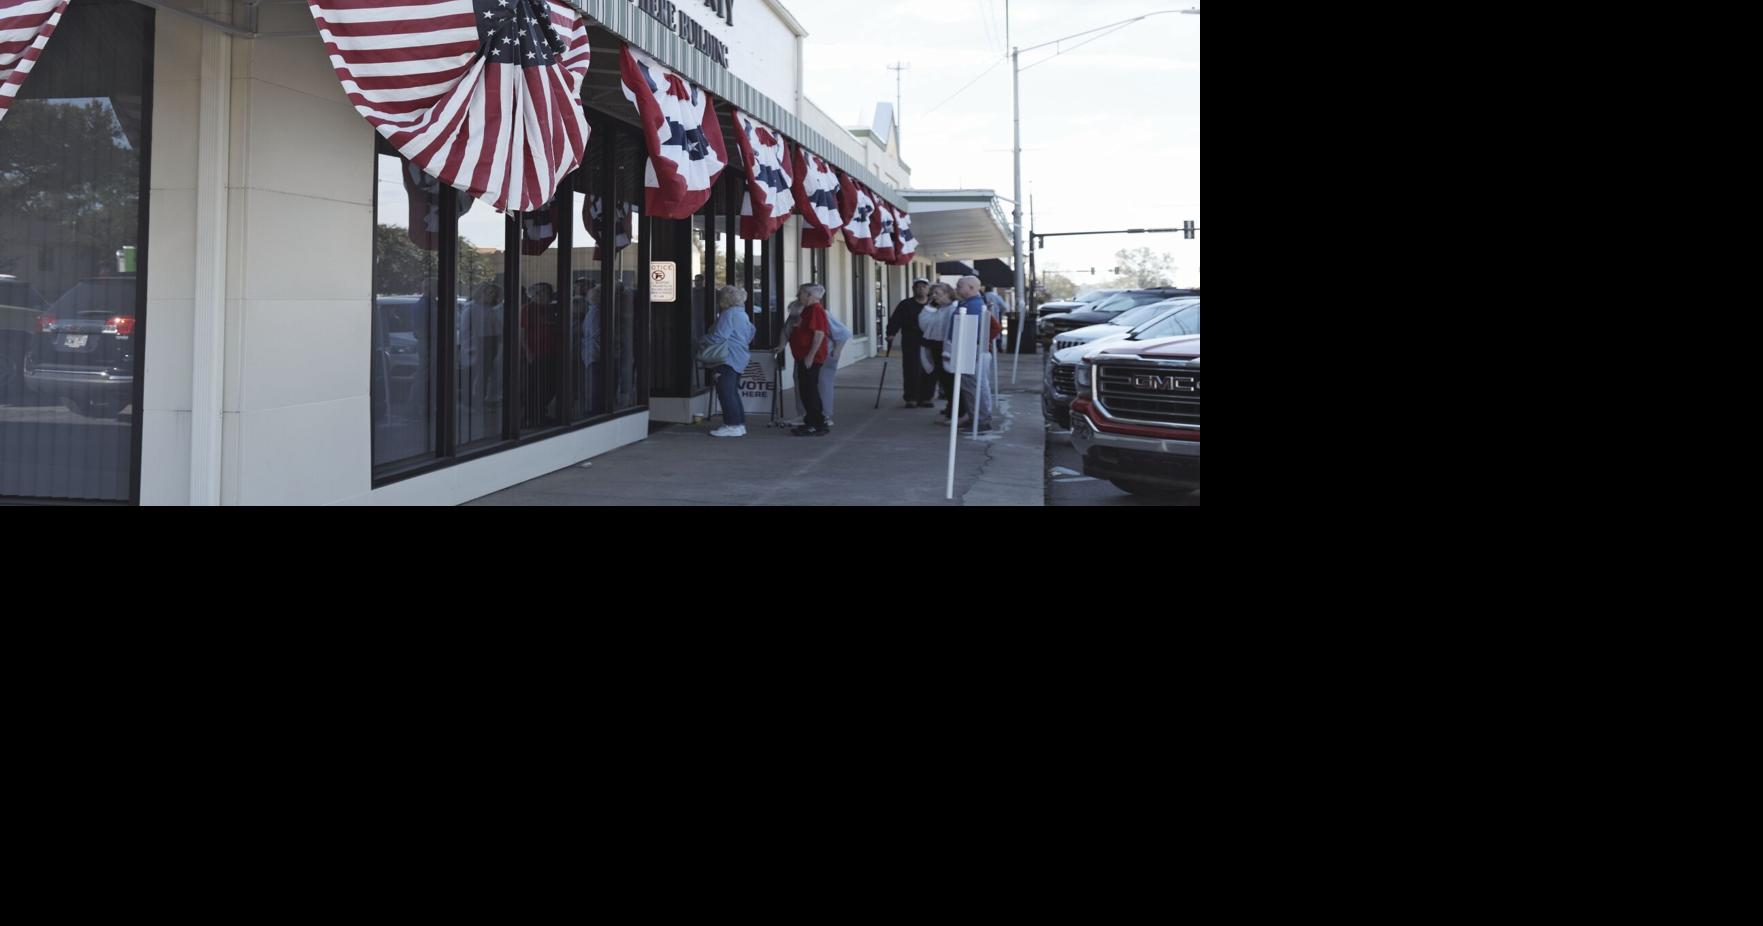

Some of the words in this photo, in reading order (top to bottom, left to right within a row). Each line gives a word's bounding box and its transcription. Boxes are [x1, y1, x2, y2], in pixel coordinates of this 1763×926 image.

[678, 10, 728, 69] BUILDING
[738, 381, 775, 390] VOTE
[1134, 375, 1194, 391] GMC
